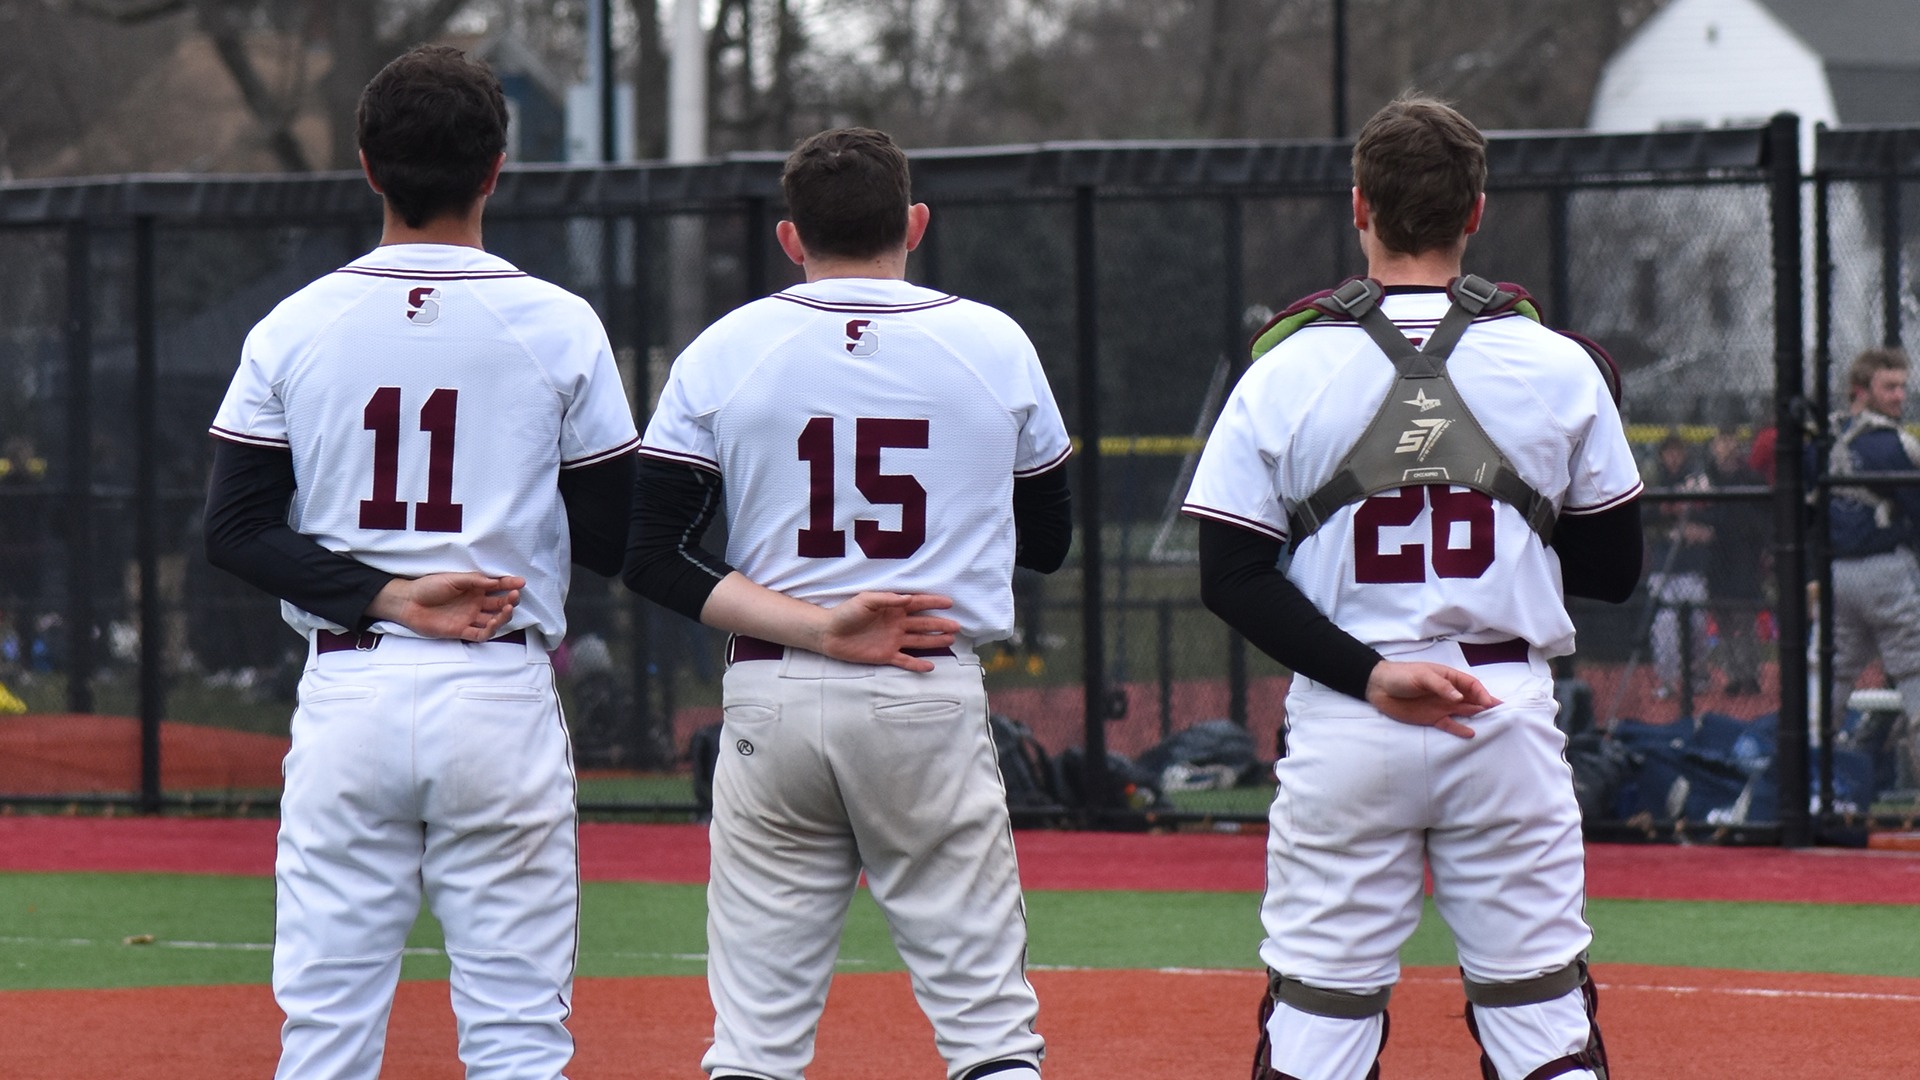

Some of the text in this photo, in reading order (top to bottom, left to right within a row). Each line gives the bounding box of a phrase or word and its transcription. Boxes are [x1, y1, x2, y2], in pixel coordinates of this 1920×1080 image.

[406, 287, 441, 325] S
[845, 319, 879, 357] S
[358, 386, 463, 533] 11
[797, 416, 930, 559] 15
